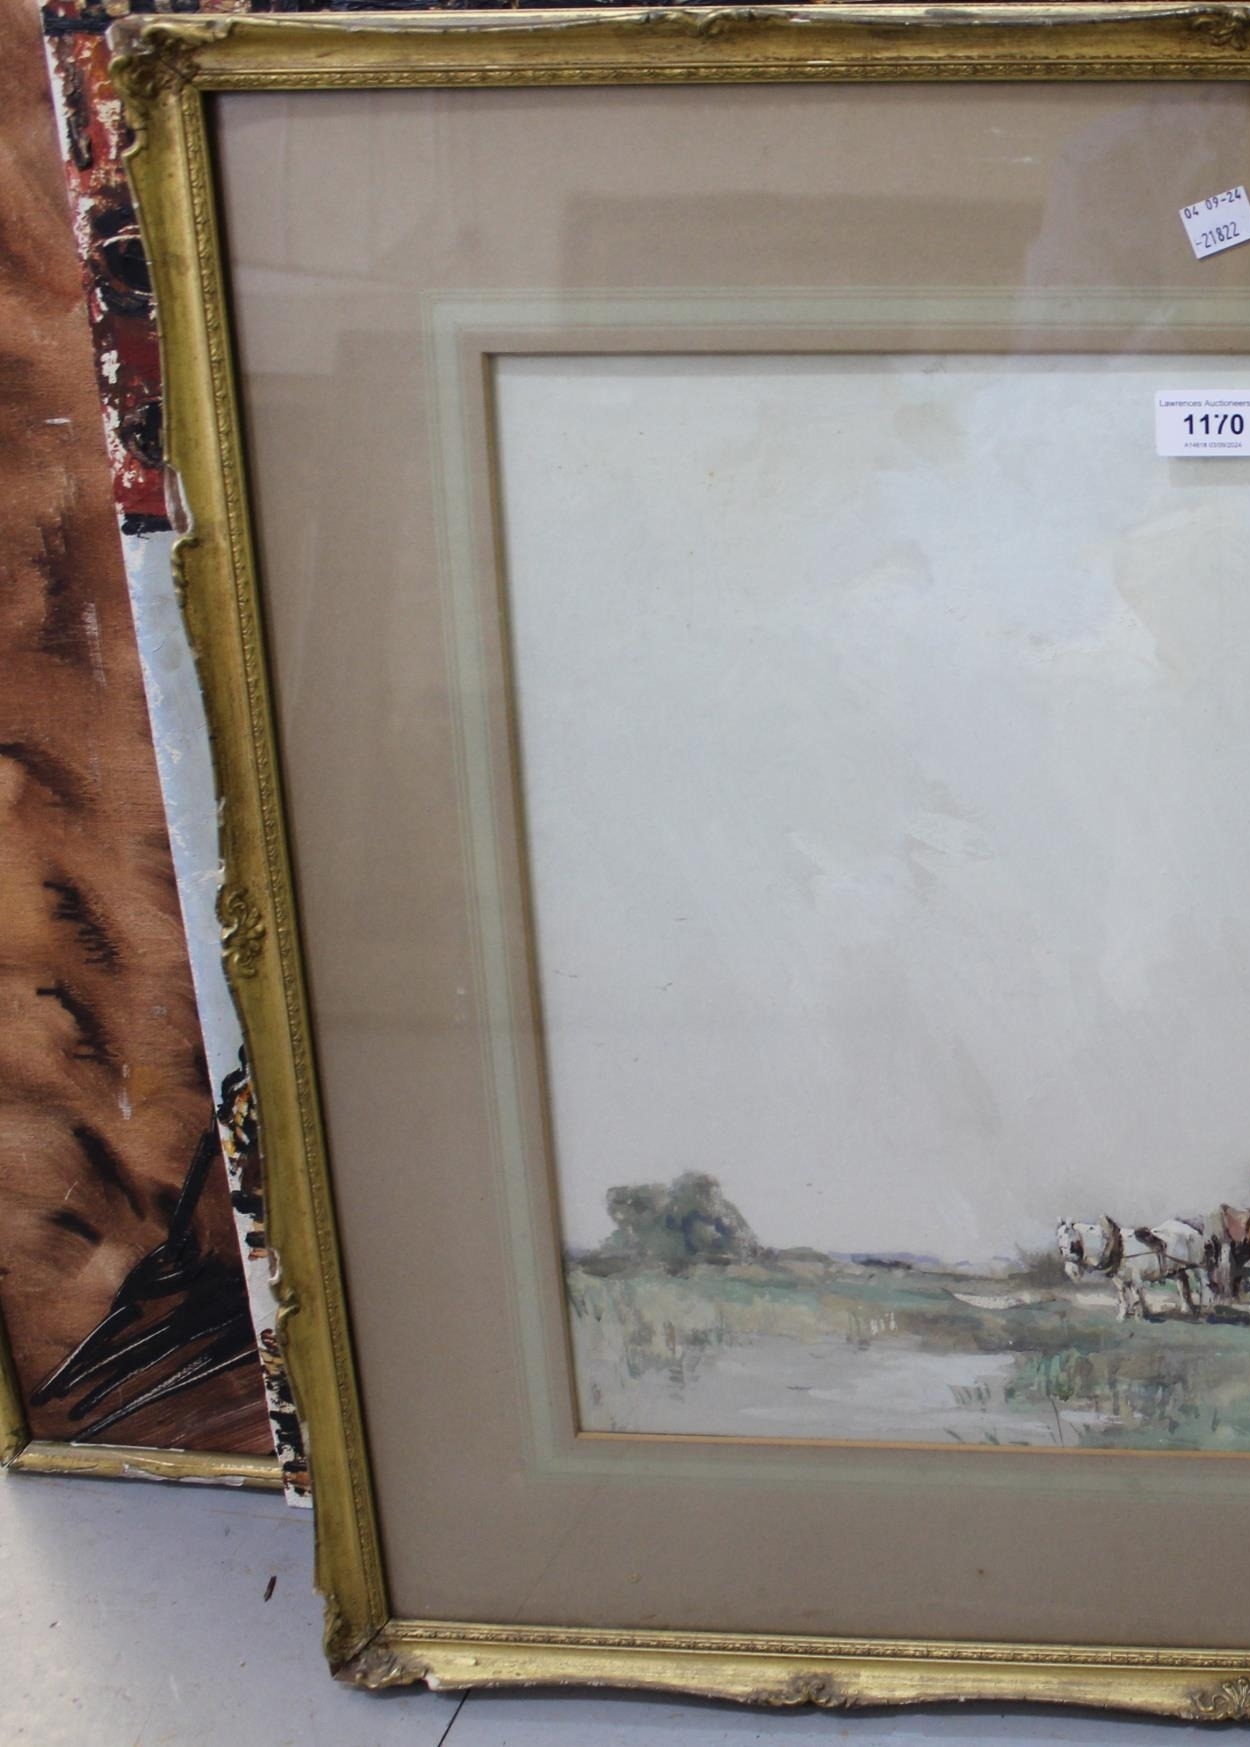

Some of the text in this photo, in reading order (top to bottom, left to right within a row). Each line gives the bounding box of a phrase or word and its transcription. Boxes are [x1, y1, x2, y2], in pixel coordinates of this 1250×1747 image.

[1159, 399, 1202, 407] Lawrences
[1204, 399, 1250, 407] Auctioneers
[1183, 413, 1244, 435] 1170
